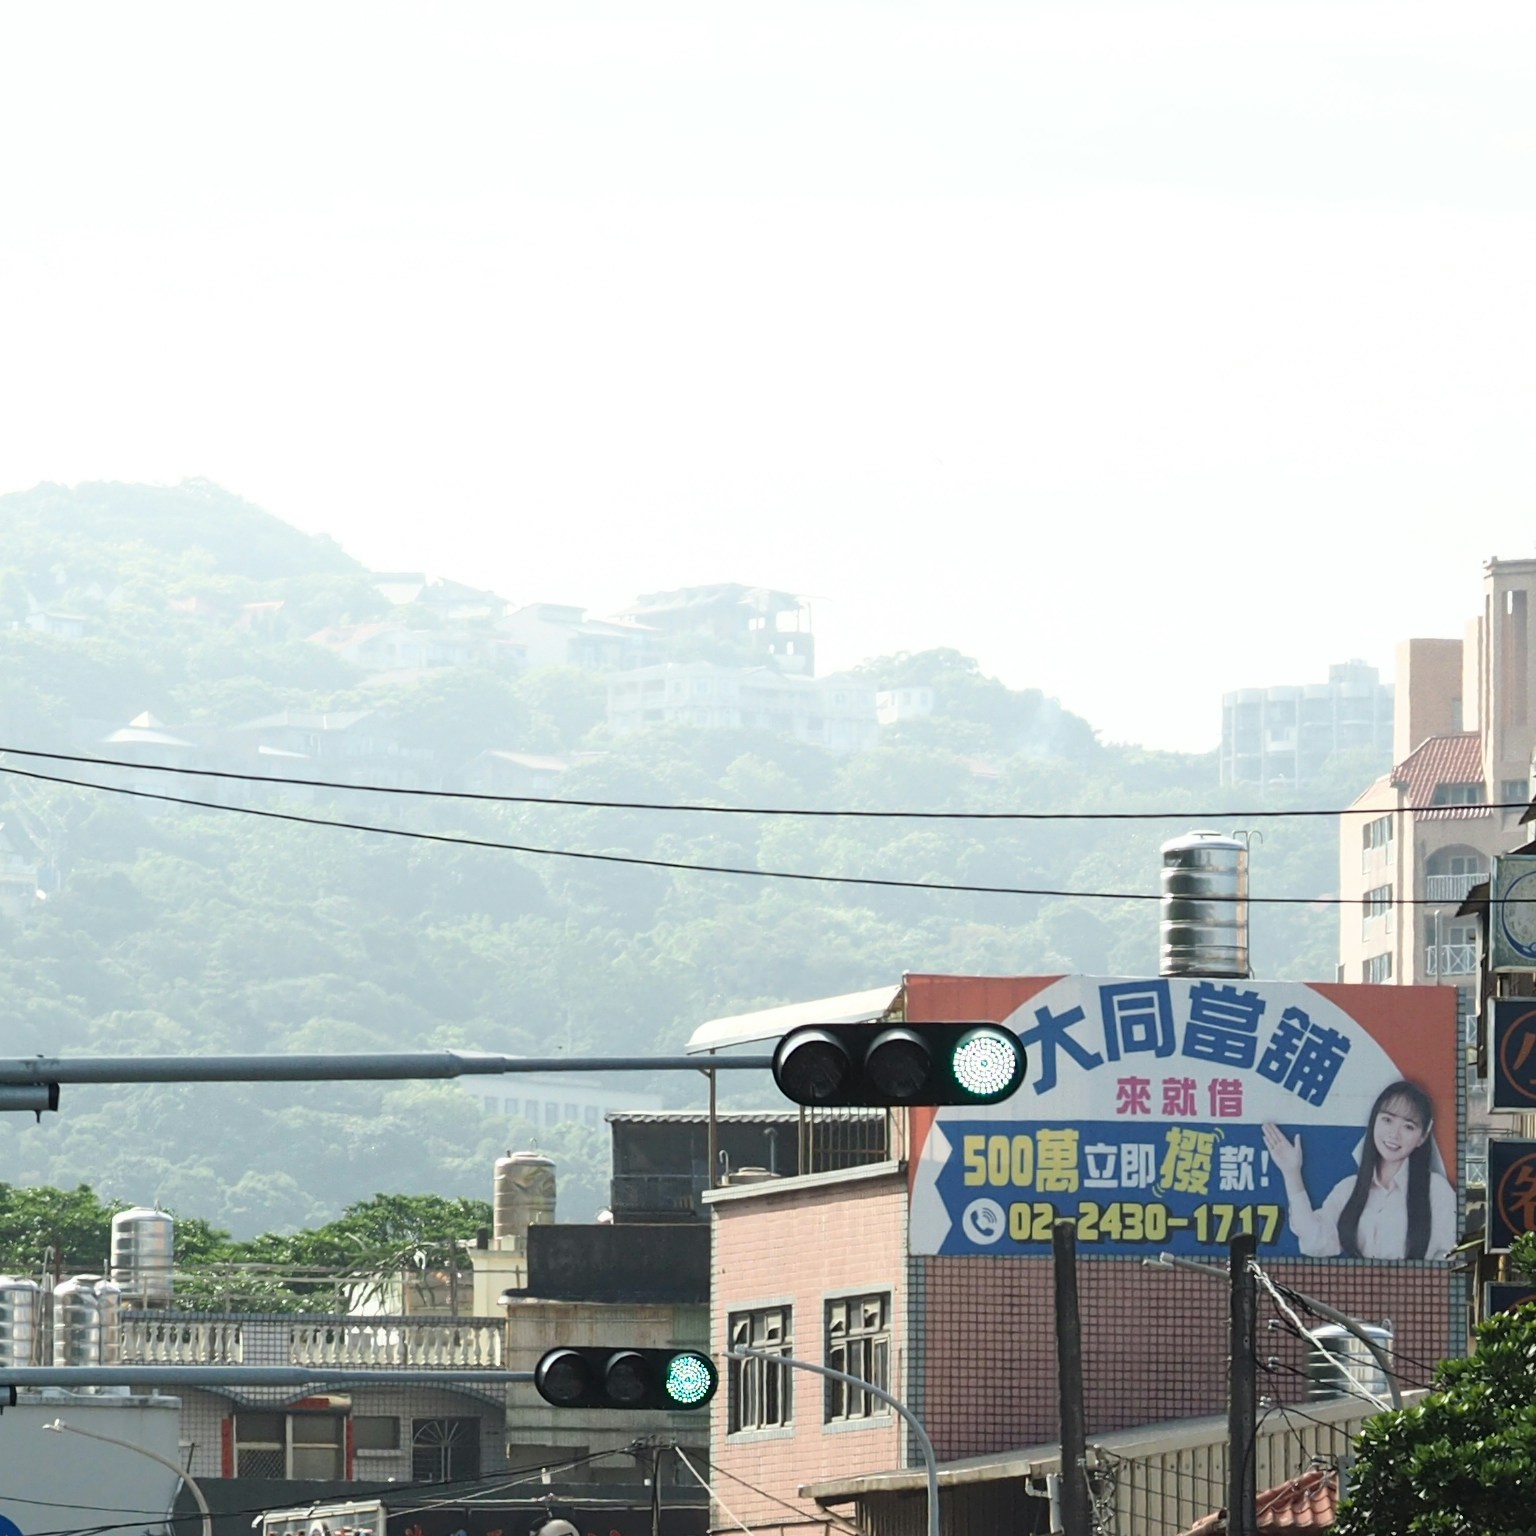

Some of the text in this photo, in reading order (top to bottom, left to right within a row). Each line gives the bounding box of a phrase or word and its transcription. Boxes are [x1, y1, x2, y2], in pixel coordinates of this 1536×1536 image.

[1017, 978, 1351, 1107] 大同當舖
[1116, 1076, 1243, 1117] 來就借
[963, 1126, 1269, 1196] 500萬立即撥款!
[1009, 1201, 1279, 1242] 02-2430-1717
